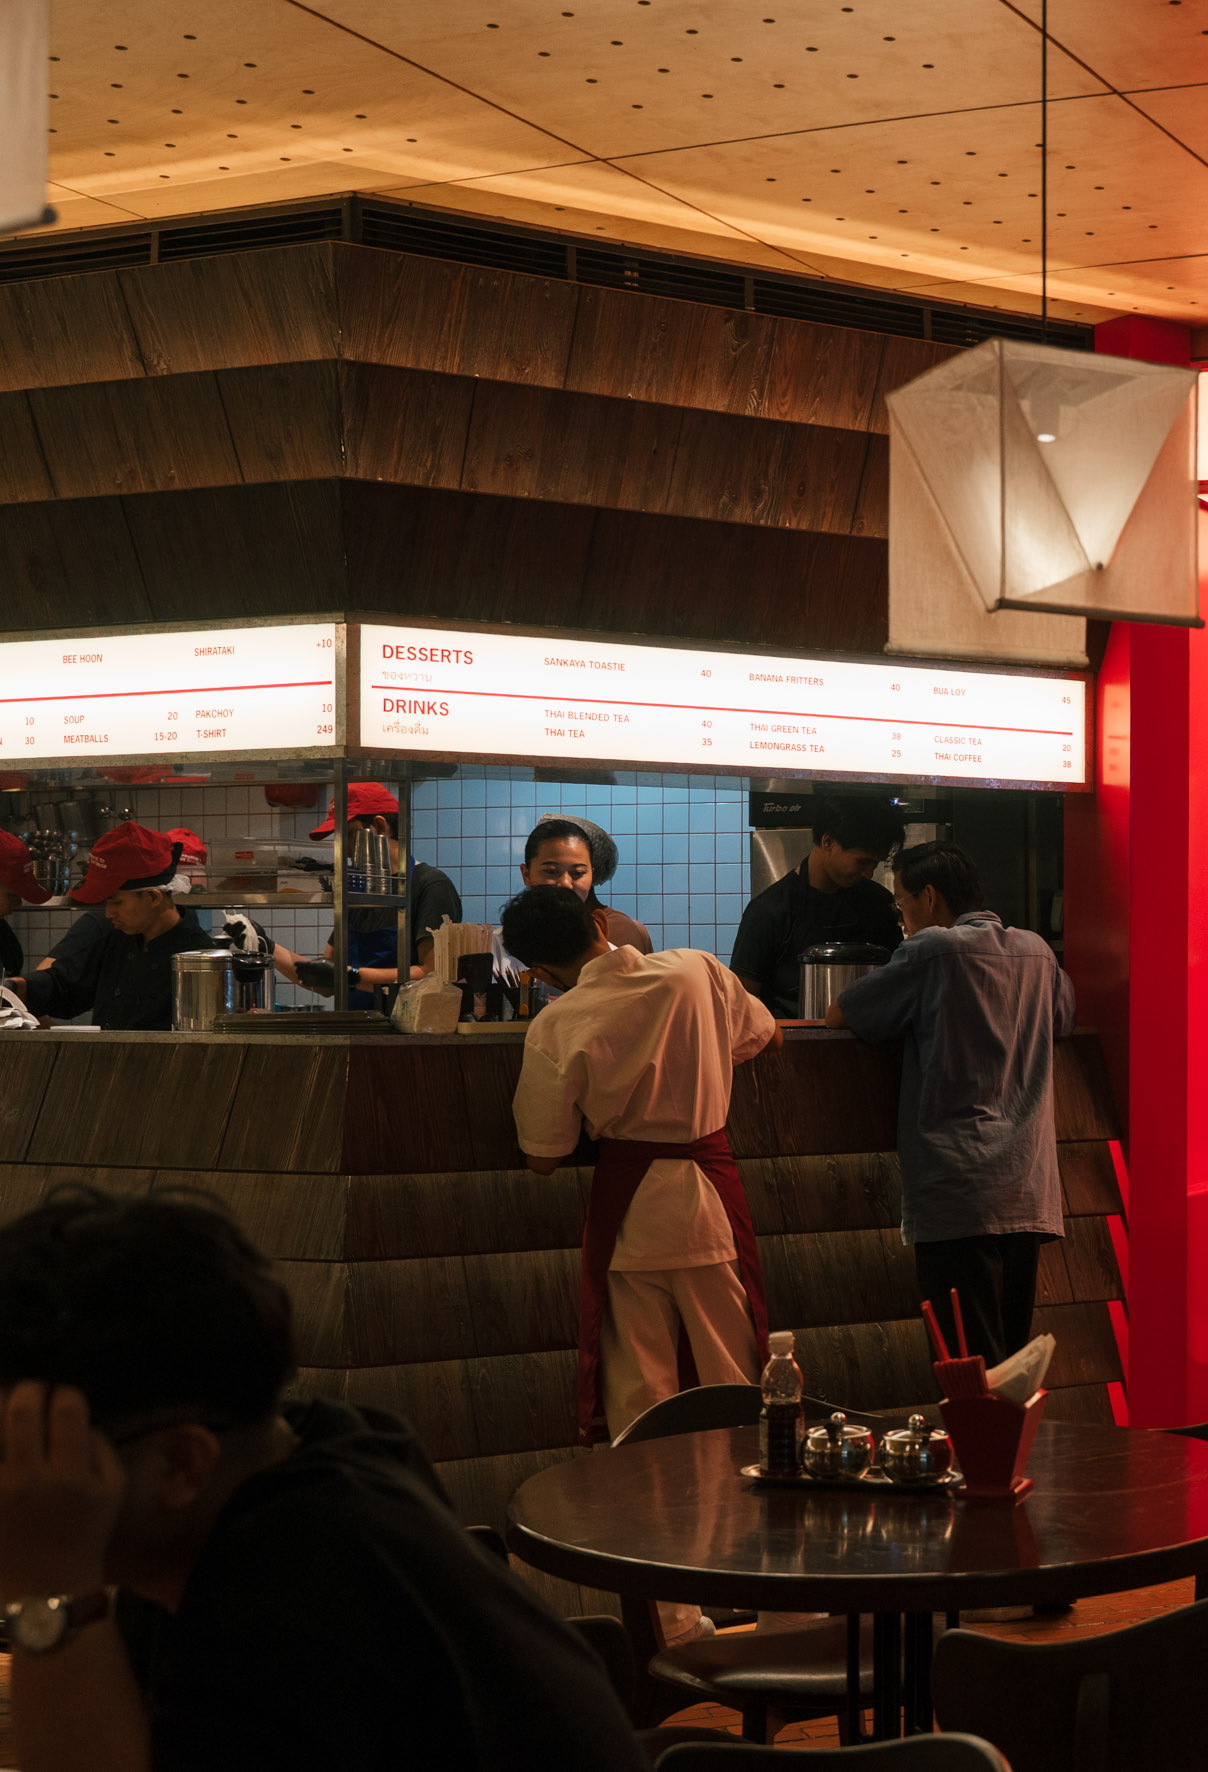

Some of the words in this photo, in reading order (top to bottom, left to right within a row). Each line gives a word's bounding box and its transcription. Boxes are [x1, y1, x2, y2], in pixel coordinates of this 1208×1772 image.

[193, 646, 235, 657] SHIRATAKI
[316, 637, 333, 649] +10
[382, 643, 474, 665] DESSERTS
[62, 654, 78, 665] BEE
[79, 653, 103, 664] HOON
[543, 657, 586, 669] SANKAYA
[588, 660, 625, 672] TOASTIE
[700, 668, 712, 678] 40
[748, 672, 784, 683] BANANA
[785, 675, 824, 687] FRITTERS
[890, 683, 901, 692] 40
[933, 686, 949, 695] BUA
[950, 687, 966, 697] LOY
[1061, 696, 1072, 705] 45
[195, 708, 233, 719] PAKCHOY
[322, 703, 333, 713] 10
[382, 697, 449, 717] DRINKS
[25, 716, 35, 727] 10
[63, 714, 85, 725] SOUP
[167, 711, 179, 721] 20
[544, 709, 565, 719] THAI
[567, 711, 610, 722] BLENDED
[613, 713, 630, 723] TEA
[701, 719, 713, 729] 40
[196, 728, 226, 739] T-SHIRT
[316, 724, 334, 735] 249
[544, 727, 566, 737] THAI
[567, 729, 585, 739] TEA
[701, 737, 713, 747] 35
[750, 722, 769, 732] THAI
[770, 724, 799, 734] GREEN
[800, 726, 817, 735] TEA
[24, 735, 36, 745] 30
[63, 733, 109, 744] MEATBALLS
[154, 731, 178, 742] 15-20
[933, 735, 966, 745] CLASSIC
[967, 737, 982, 746] TEA
[1061, 743, 1072, 753] 20
[749, 740, 807, 752] LEMONGRASS
[808, 744, 825, 753] TEA
[891, 749, 902, 758] 25
[934, 752, 952, 761] THAI
[953, 753, 983, 763] COFFEE
[762, 802, 788, 813] Turbo
[789, 804, 801, 812] air
